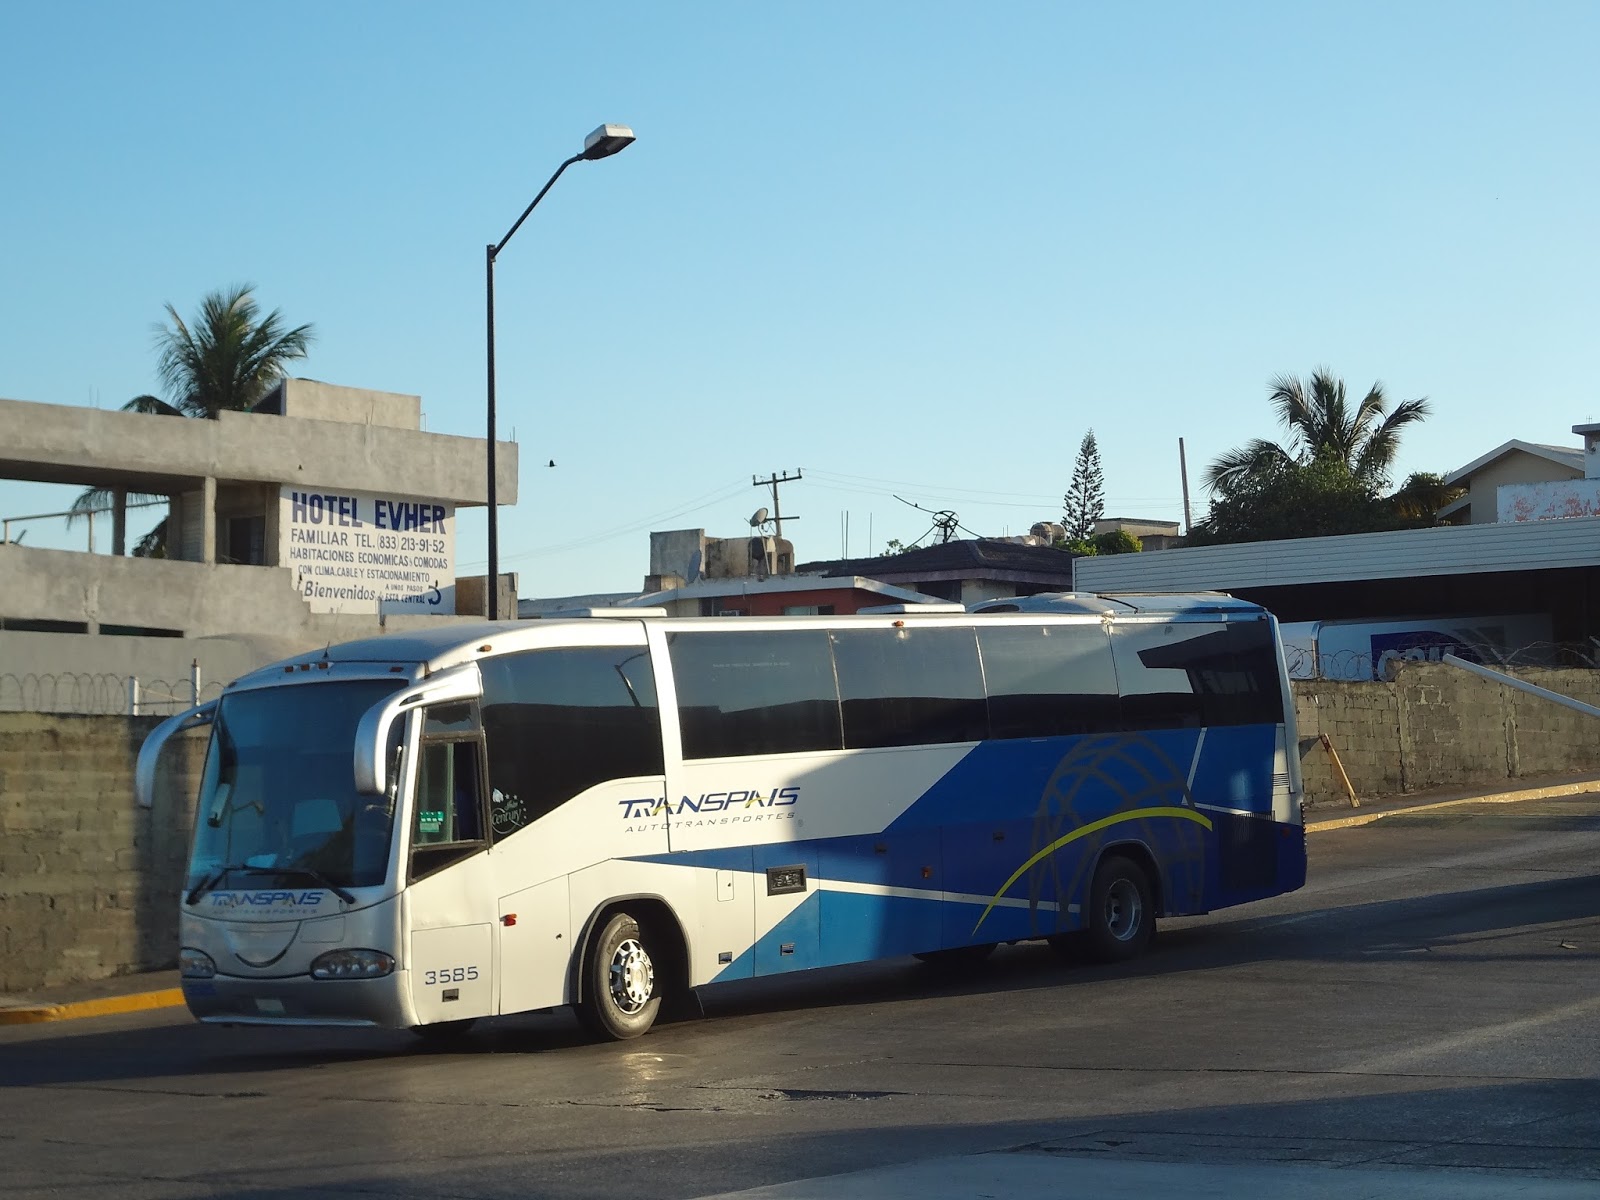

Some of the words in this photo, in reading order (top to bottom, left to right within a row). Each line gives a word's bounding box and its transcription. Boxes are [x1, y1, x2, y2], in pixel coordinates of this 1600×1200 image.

[292, 491, 363, 528] HOTEL
[374, 499, 447, 535] EVHER
[291, 528, 348, 546] FAMILIAR
[354, 532, 375, 548] TEL.
[377, 533, 400, 552] (833)
[401, 536, 445, 554] 213-91-52
[290, 546, 354, 562] HABITACIONES
[358, 552, 409, 567] ECONOMICAS
[413, 556, 448, 570] COMODAS
[298, 564, 312, 575] CON
[359, 568, 365, 578] Y
[367, 568, 430, 582] ESTACIONAMIENTO
[303, 580, 375, 601] Bienvenidos
[625, 811, 796, 833] AUTOTRANSPORTES
[424, 966, 480, 985] 3585
